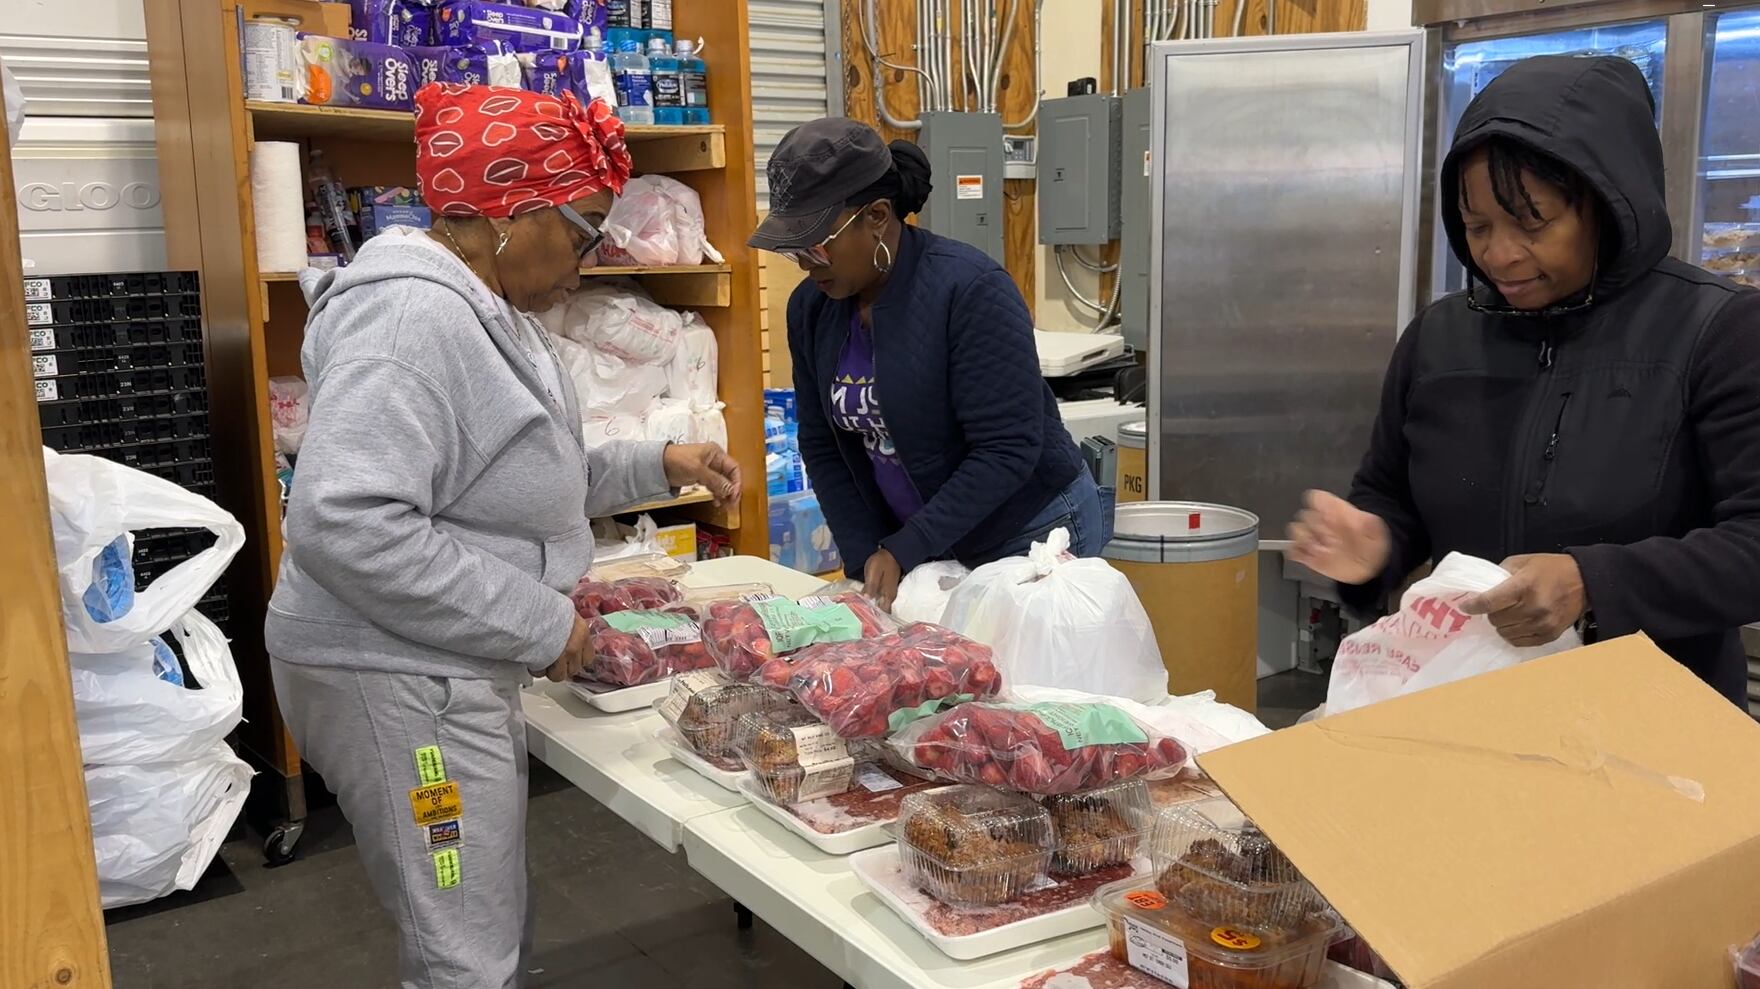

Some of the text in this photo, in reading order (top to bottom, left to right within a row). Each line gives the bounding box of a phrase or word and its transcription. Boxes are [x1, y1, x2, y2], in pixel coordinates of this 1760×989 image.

[384, 57, 398, 102] Overs
[396, 61, 409, 101] Sleep
[604, 418, 620, 437] 6
[1123, 474, 1143, 494] PKG
[416, 785, 453, 801] MOMENT
[431, 796, 443, 806] OF
[422, 806, 457, 818] AMBITIONS
